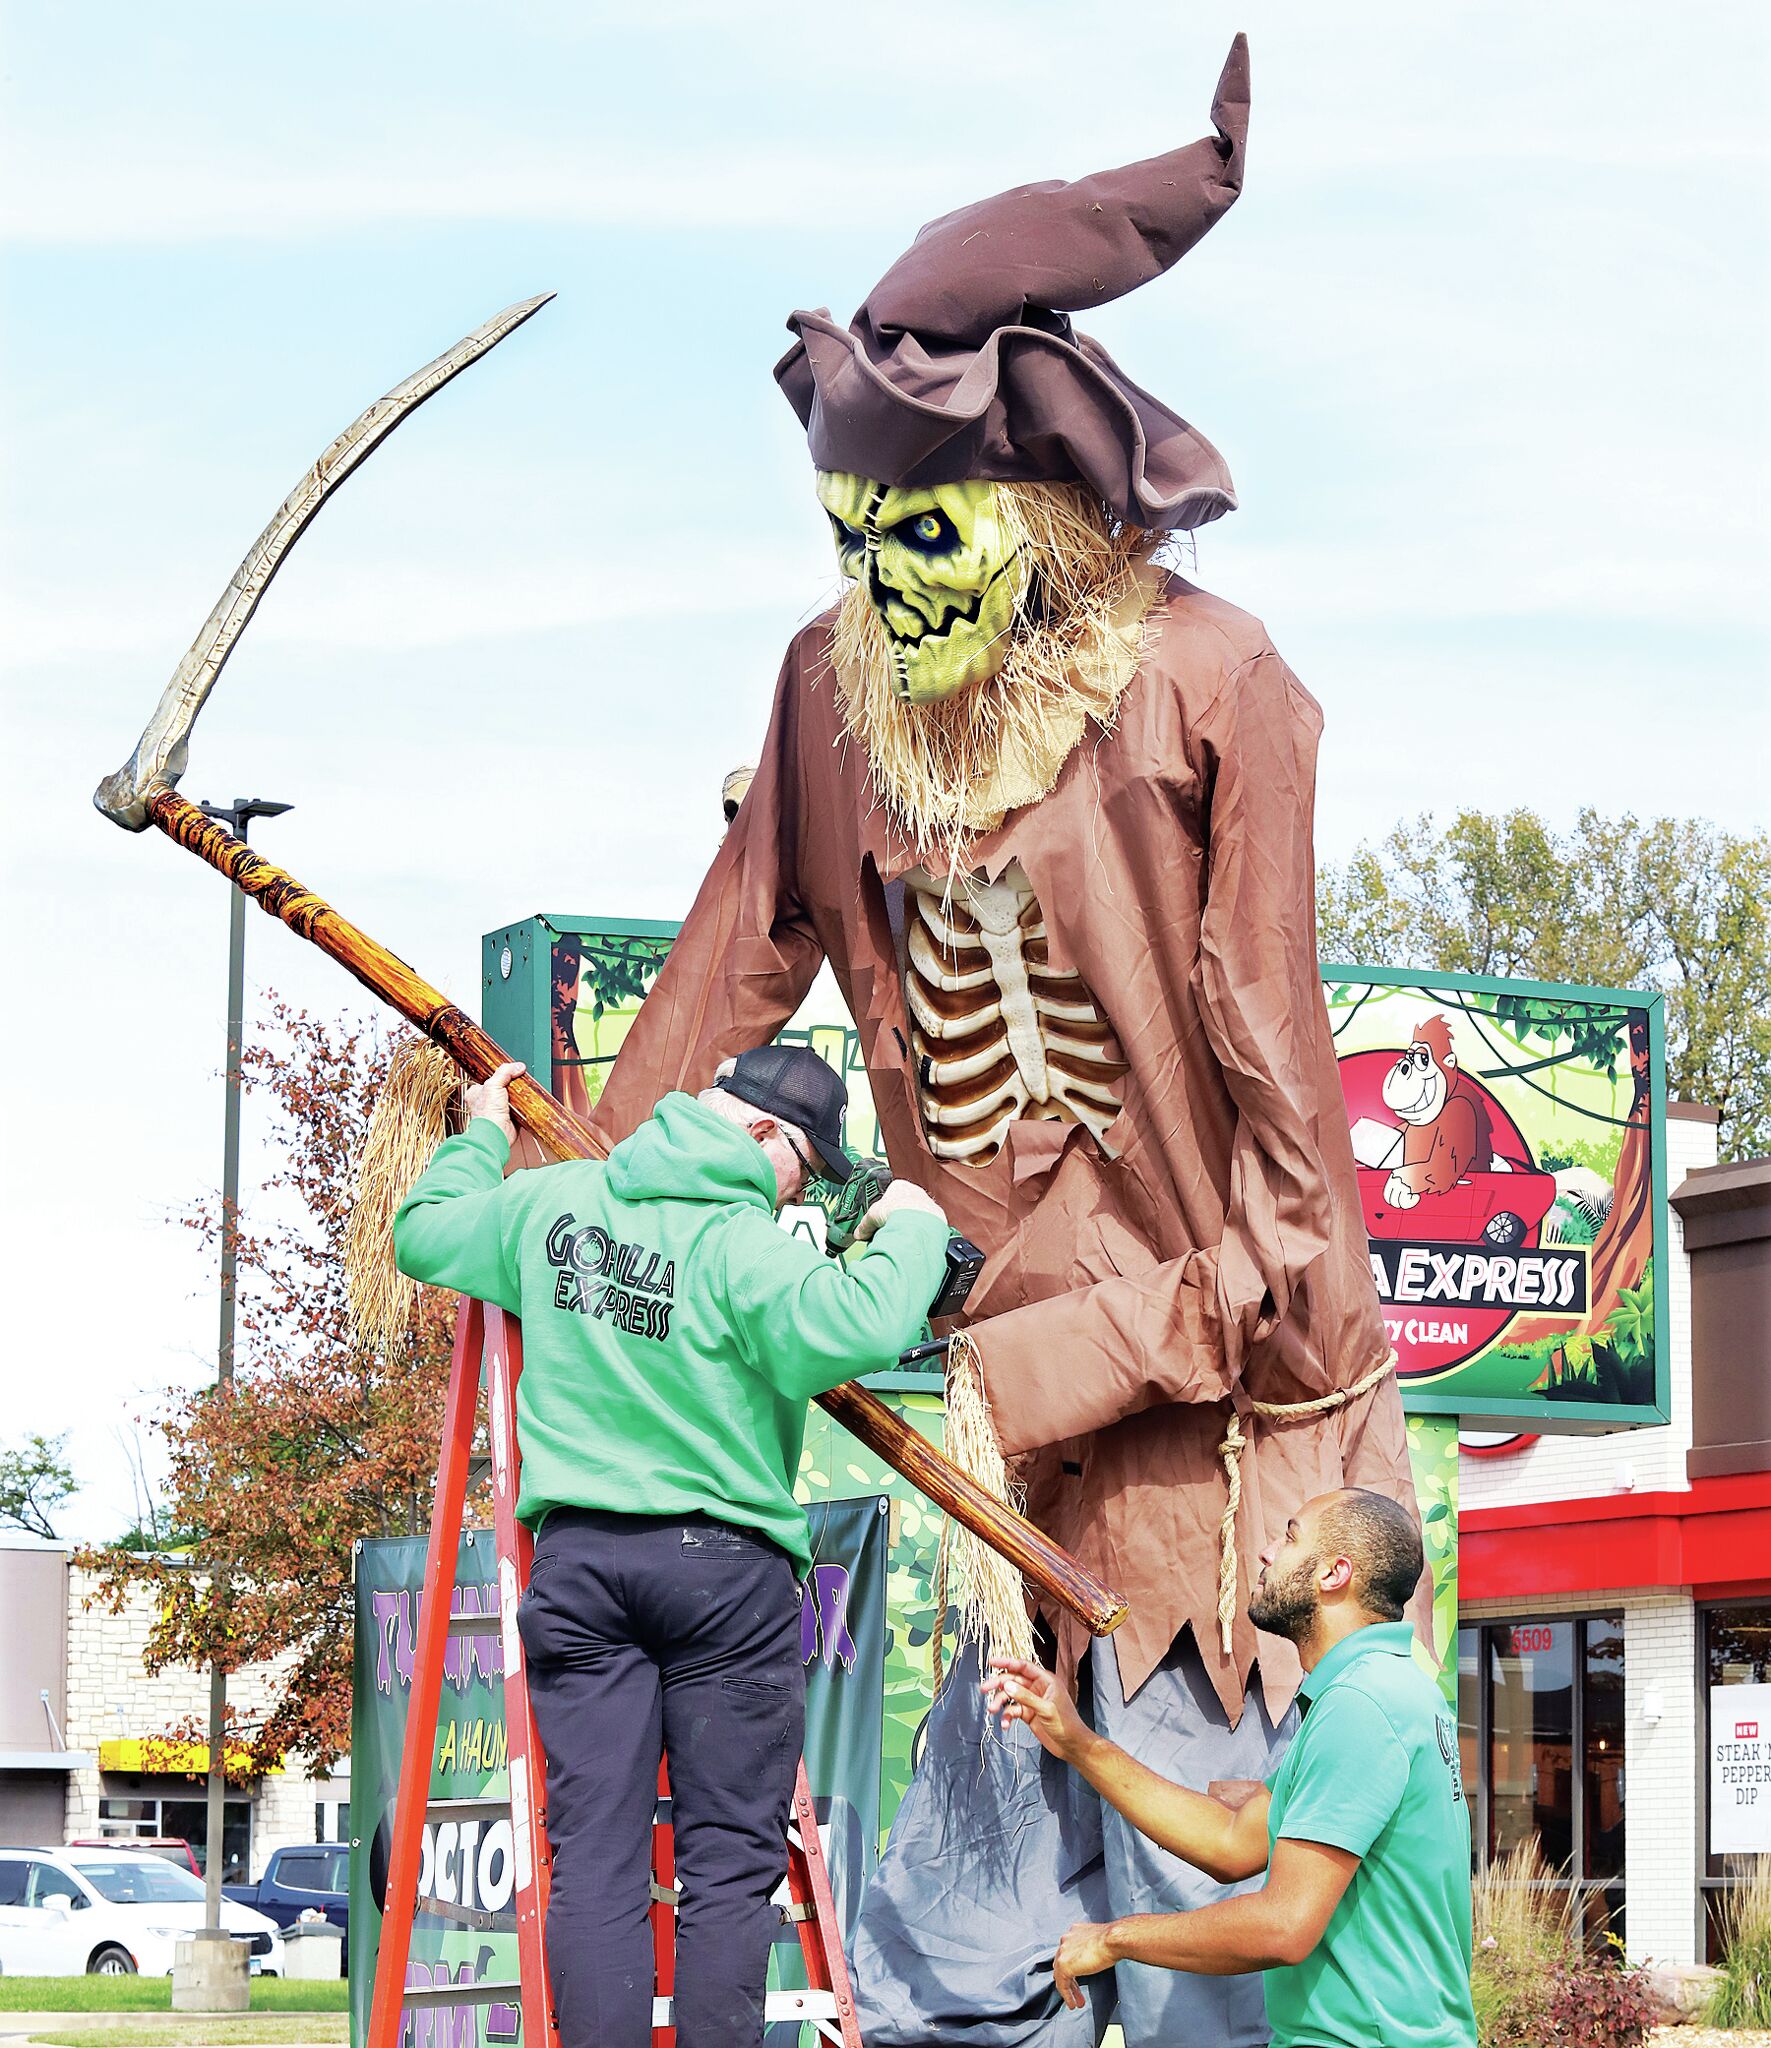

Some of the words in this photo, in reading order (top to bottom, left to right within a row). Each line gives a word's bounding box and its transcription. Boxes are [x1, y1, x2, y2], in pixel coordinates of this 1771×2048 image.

[546, 1212, 675, 1298] GORILLA
[1394, 1248, 1580, 1307] EXPRESS
[554, 1269, 675, 1343] EXPRESS
[1404, 1318, 1468, 1346] CLEAN
[1511, 1627, 1553, 1654] 5509
[1736, 1724, 1758, 1737] NEW
[438, 1719, 458, 1774] A
[459, 1718, 509, 1775] HAUN
[1716, 1743, 1761, 1762] STEAK
[1722, 1765, 1771, 1783] PEPPER
[1736, 1788, 1758, 1805] DIP
